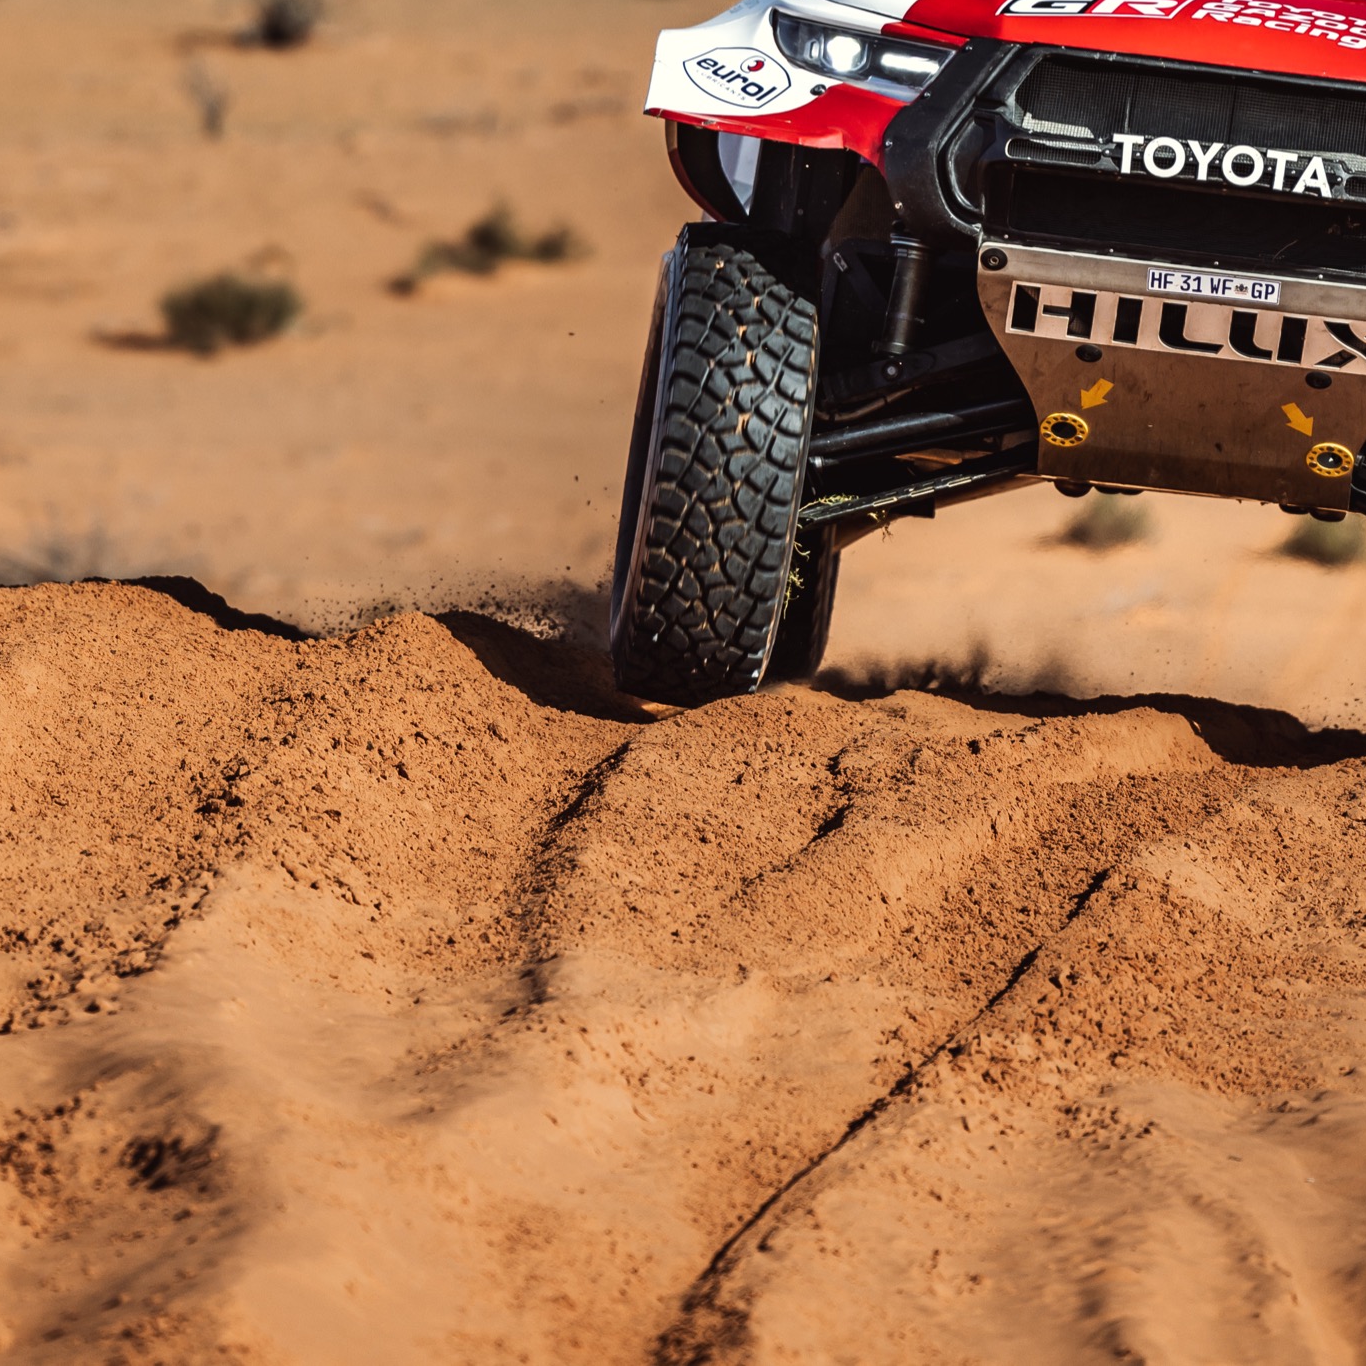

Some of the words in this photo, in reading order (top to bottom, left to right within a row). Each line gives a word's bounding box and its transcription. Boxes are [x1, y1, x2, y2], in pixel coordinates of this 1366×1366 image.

[696, 57, 778, 102] eurol
[1112, 133, 1333, 198] TOYOTA
[1150, 271, 1175, 290] HF
[1180, 274, 1202, 293] 31
[1210, 277, 1233, 295] WF
[1251, 282, 1275, 300] GP
